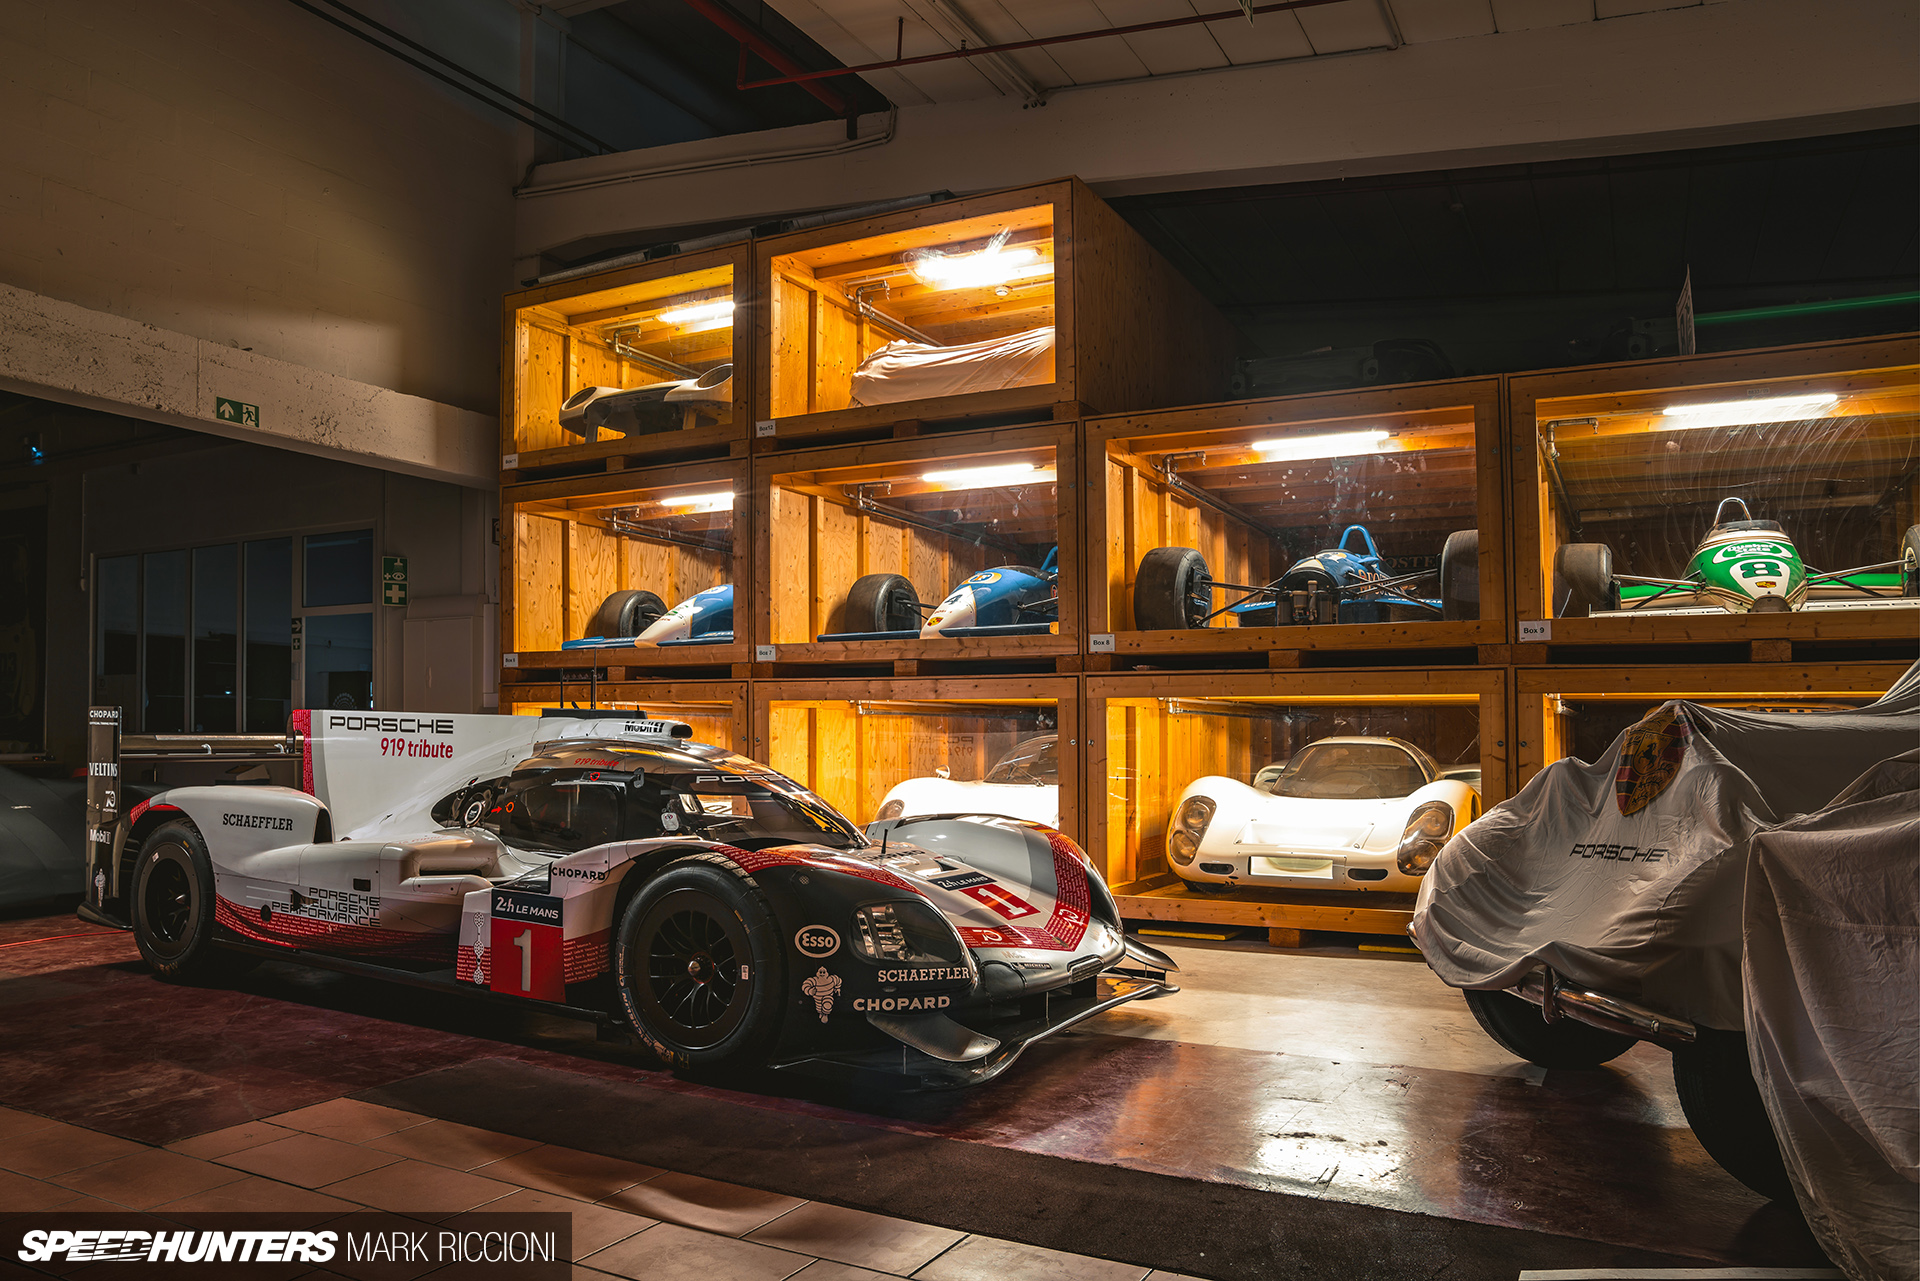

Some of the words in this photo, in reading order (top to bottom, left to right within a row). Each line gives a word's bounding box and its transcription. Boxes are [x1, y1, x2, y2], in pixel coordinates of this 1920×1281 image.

[1740, 561, 1783, 579] 8
[89, 710, 119, 719] CHOPARD
[329, 715, 454, 735] PORSCHE
[380, 737, 406, 757] 919
[407, 738, 453, 759] tribute
[88, 762, 118, 777] VELTINS
[573, 758, 592, 766] 919
[590, 758, 620, 767] tribute
[222, 813, 294, 831] SCHAEFFLER
[1569, 843, 1669, 863] PORSCHE
[551, 866, 606, 881] CHOPARD
[308, 887, 381, 906] PORSCHE
[977, 886, 1028, 916] 1
[495, 896, 515, 913] 24h
[516, 905, 528, 915] LE
[529, 906, 559, 919] MANS
[513, 928, 532, 992] 1
[878, 967, 970, 983] SCHAEFFLER
[852, 996, 951, 1012] CHOPARD
